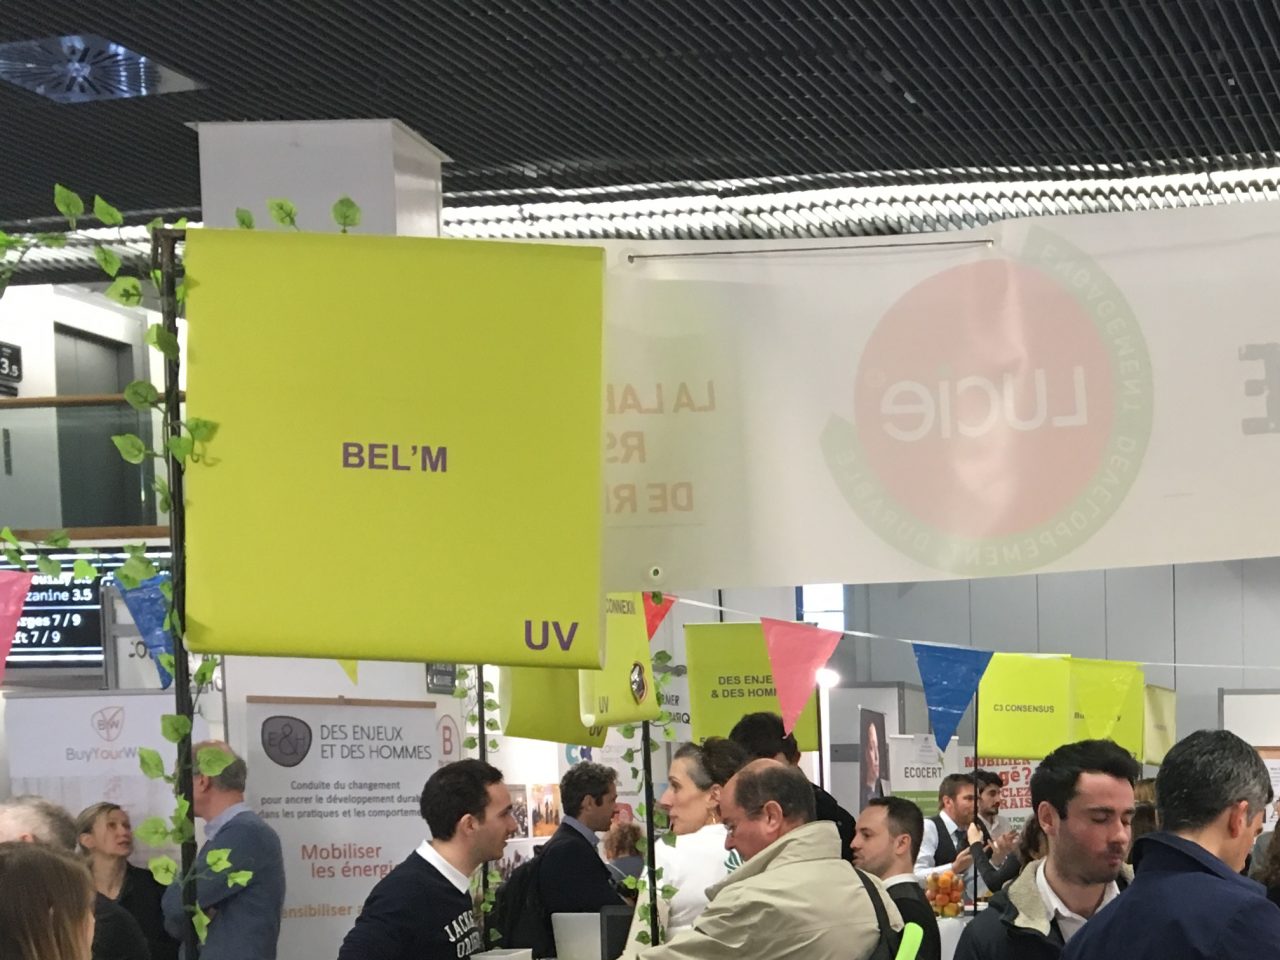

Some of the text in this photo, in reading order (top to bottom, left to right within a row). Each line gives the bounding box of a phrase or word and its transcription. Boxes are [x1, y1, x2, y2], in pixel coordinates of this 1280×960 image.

[341, 442, 448, 473] BEL'M
[26, 588, 93, 601] zanine 3.5
[52, 614, 61, 626] 7
[72, 614, 82, 626] 9
[31, 631, 39, 643] 7
[52, 631, 61, 643] 9
[524, 620, 579, 651] UV
[718, 675, 773, 685] DES ENJE
[711, 688, 777, 698] & DES HOM
[1005, 704, 1055, 713] CONSENSUS
[320, 725, 403, 741] DES ENJEUX
[66, 747, 138, 763] BuyYourW
[321, 744, 432, 760] ET DES HOMMES
[904, 767, 942, 778] ECOCERT
[291, 780, 401, 792] Conduite du changement
[261, 794, 422, 806] pour ancrer le développement durab
[282, 809, 294, 819] les
[297, 809, 339, 820] pratiques
[342, 809, 351, 818] et
[353, 808, 366, 817] les
[368, 809, 422, 819] comporteme
[301, 843, 382, 860] Mobiliser
[311, 860, 397, 879] les énergi
[280, 904, 352, 919] ensibiliser
